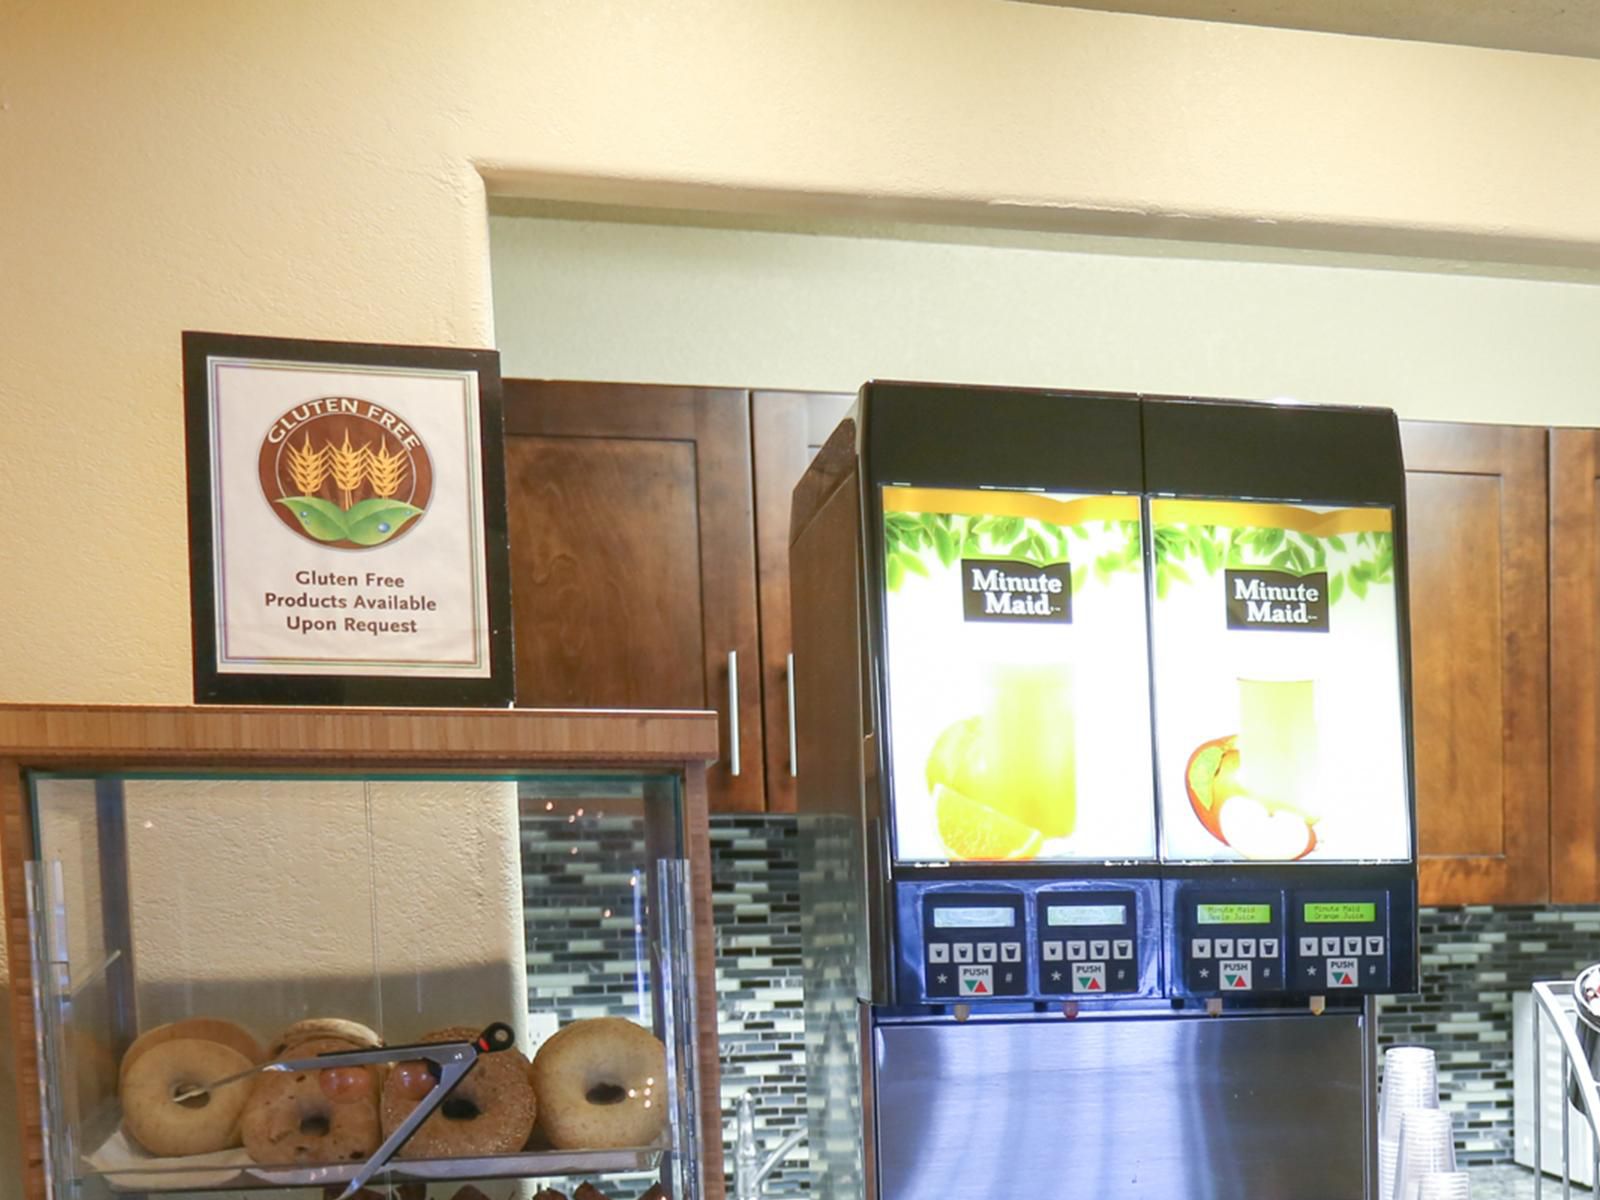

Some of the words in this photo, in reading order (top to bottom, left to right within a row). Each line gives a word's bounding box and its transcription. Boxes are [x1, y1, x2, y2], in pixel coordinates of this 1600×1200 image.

[268, 398, 358, 444] GLUTEN
[367, 405, 421, 451] FREE
[295, 570, 359, 587] Gluten
[365, 572, 405, 588] Free
[971, 568, 1063, 594] Minute
[1234, 578, 1319, 602] Minute
[264, 592, 348, 609] Products
[353, 595, 437, 612] Available
[984, 591, 1052, 616] Maid
[1246, 600, 1309, 623] Maid
[286, 616, 337, 635] Upon
[344, 617, 418, 636] Request
[962, 967, 990, 977] PUSH
[1075, 964, 1103, 974] PUSH
[1223, 962, 1249, 972] PUSH
[1330, 960, 1356, 970] PUSH
